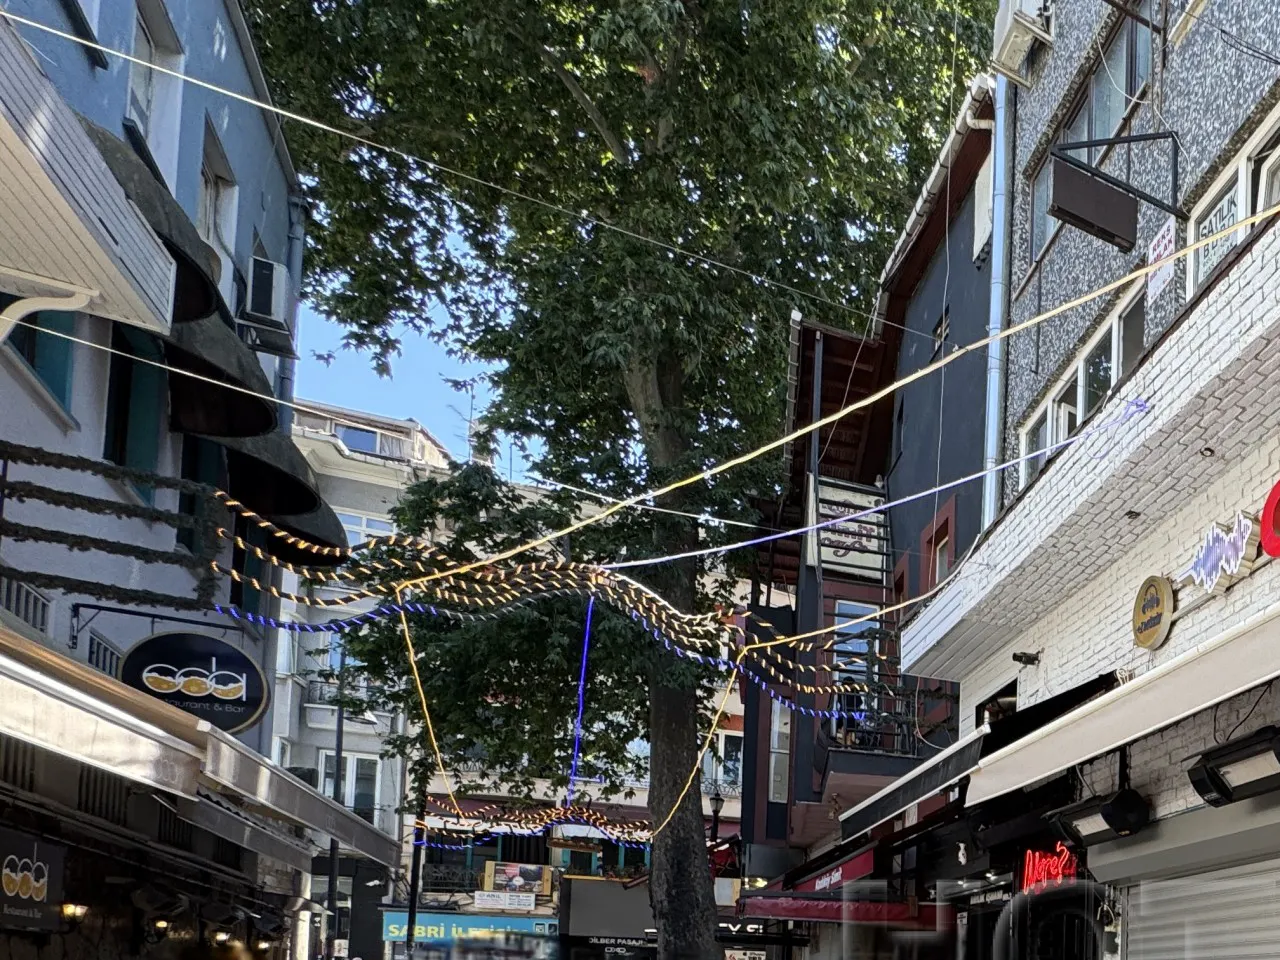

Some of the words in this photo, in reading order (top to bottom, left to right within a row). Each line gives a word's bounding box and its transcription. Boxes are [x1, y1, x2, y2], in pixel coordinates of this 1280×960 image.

[1200, 190, 1238, 239] SATILIK
[165, 699, 211, 711] aurant
[225, 704, 246, 713] Bar
